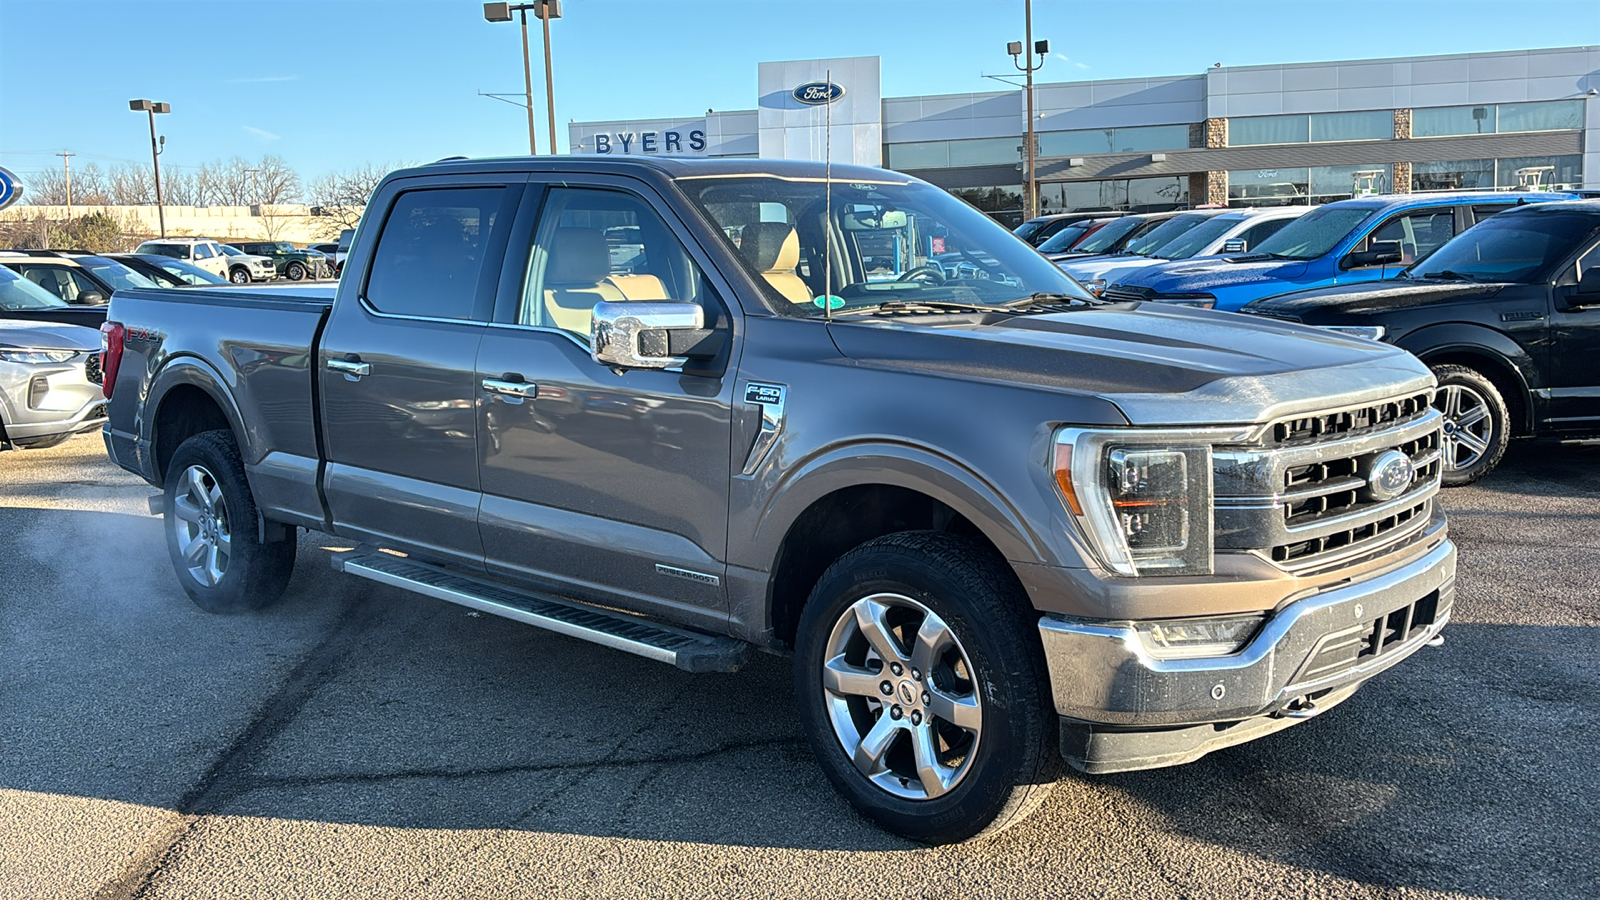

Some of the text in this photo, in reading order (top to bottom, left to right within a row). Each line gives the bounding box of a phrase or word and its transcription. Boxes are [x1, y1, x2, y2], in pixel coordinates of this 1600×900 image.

[803, 86, 833, 99] Ford
[594, 130, 706, 154] BYERS
[1257, 169, 1278, 178] Ford
[126, 327, 160, 343] FX4
[755, 395, 778, 403] LARIAT
[657, 566, 716, 583] POWERBOOST
